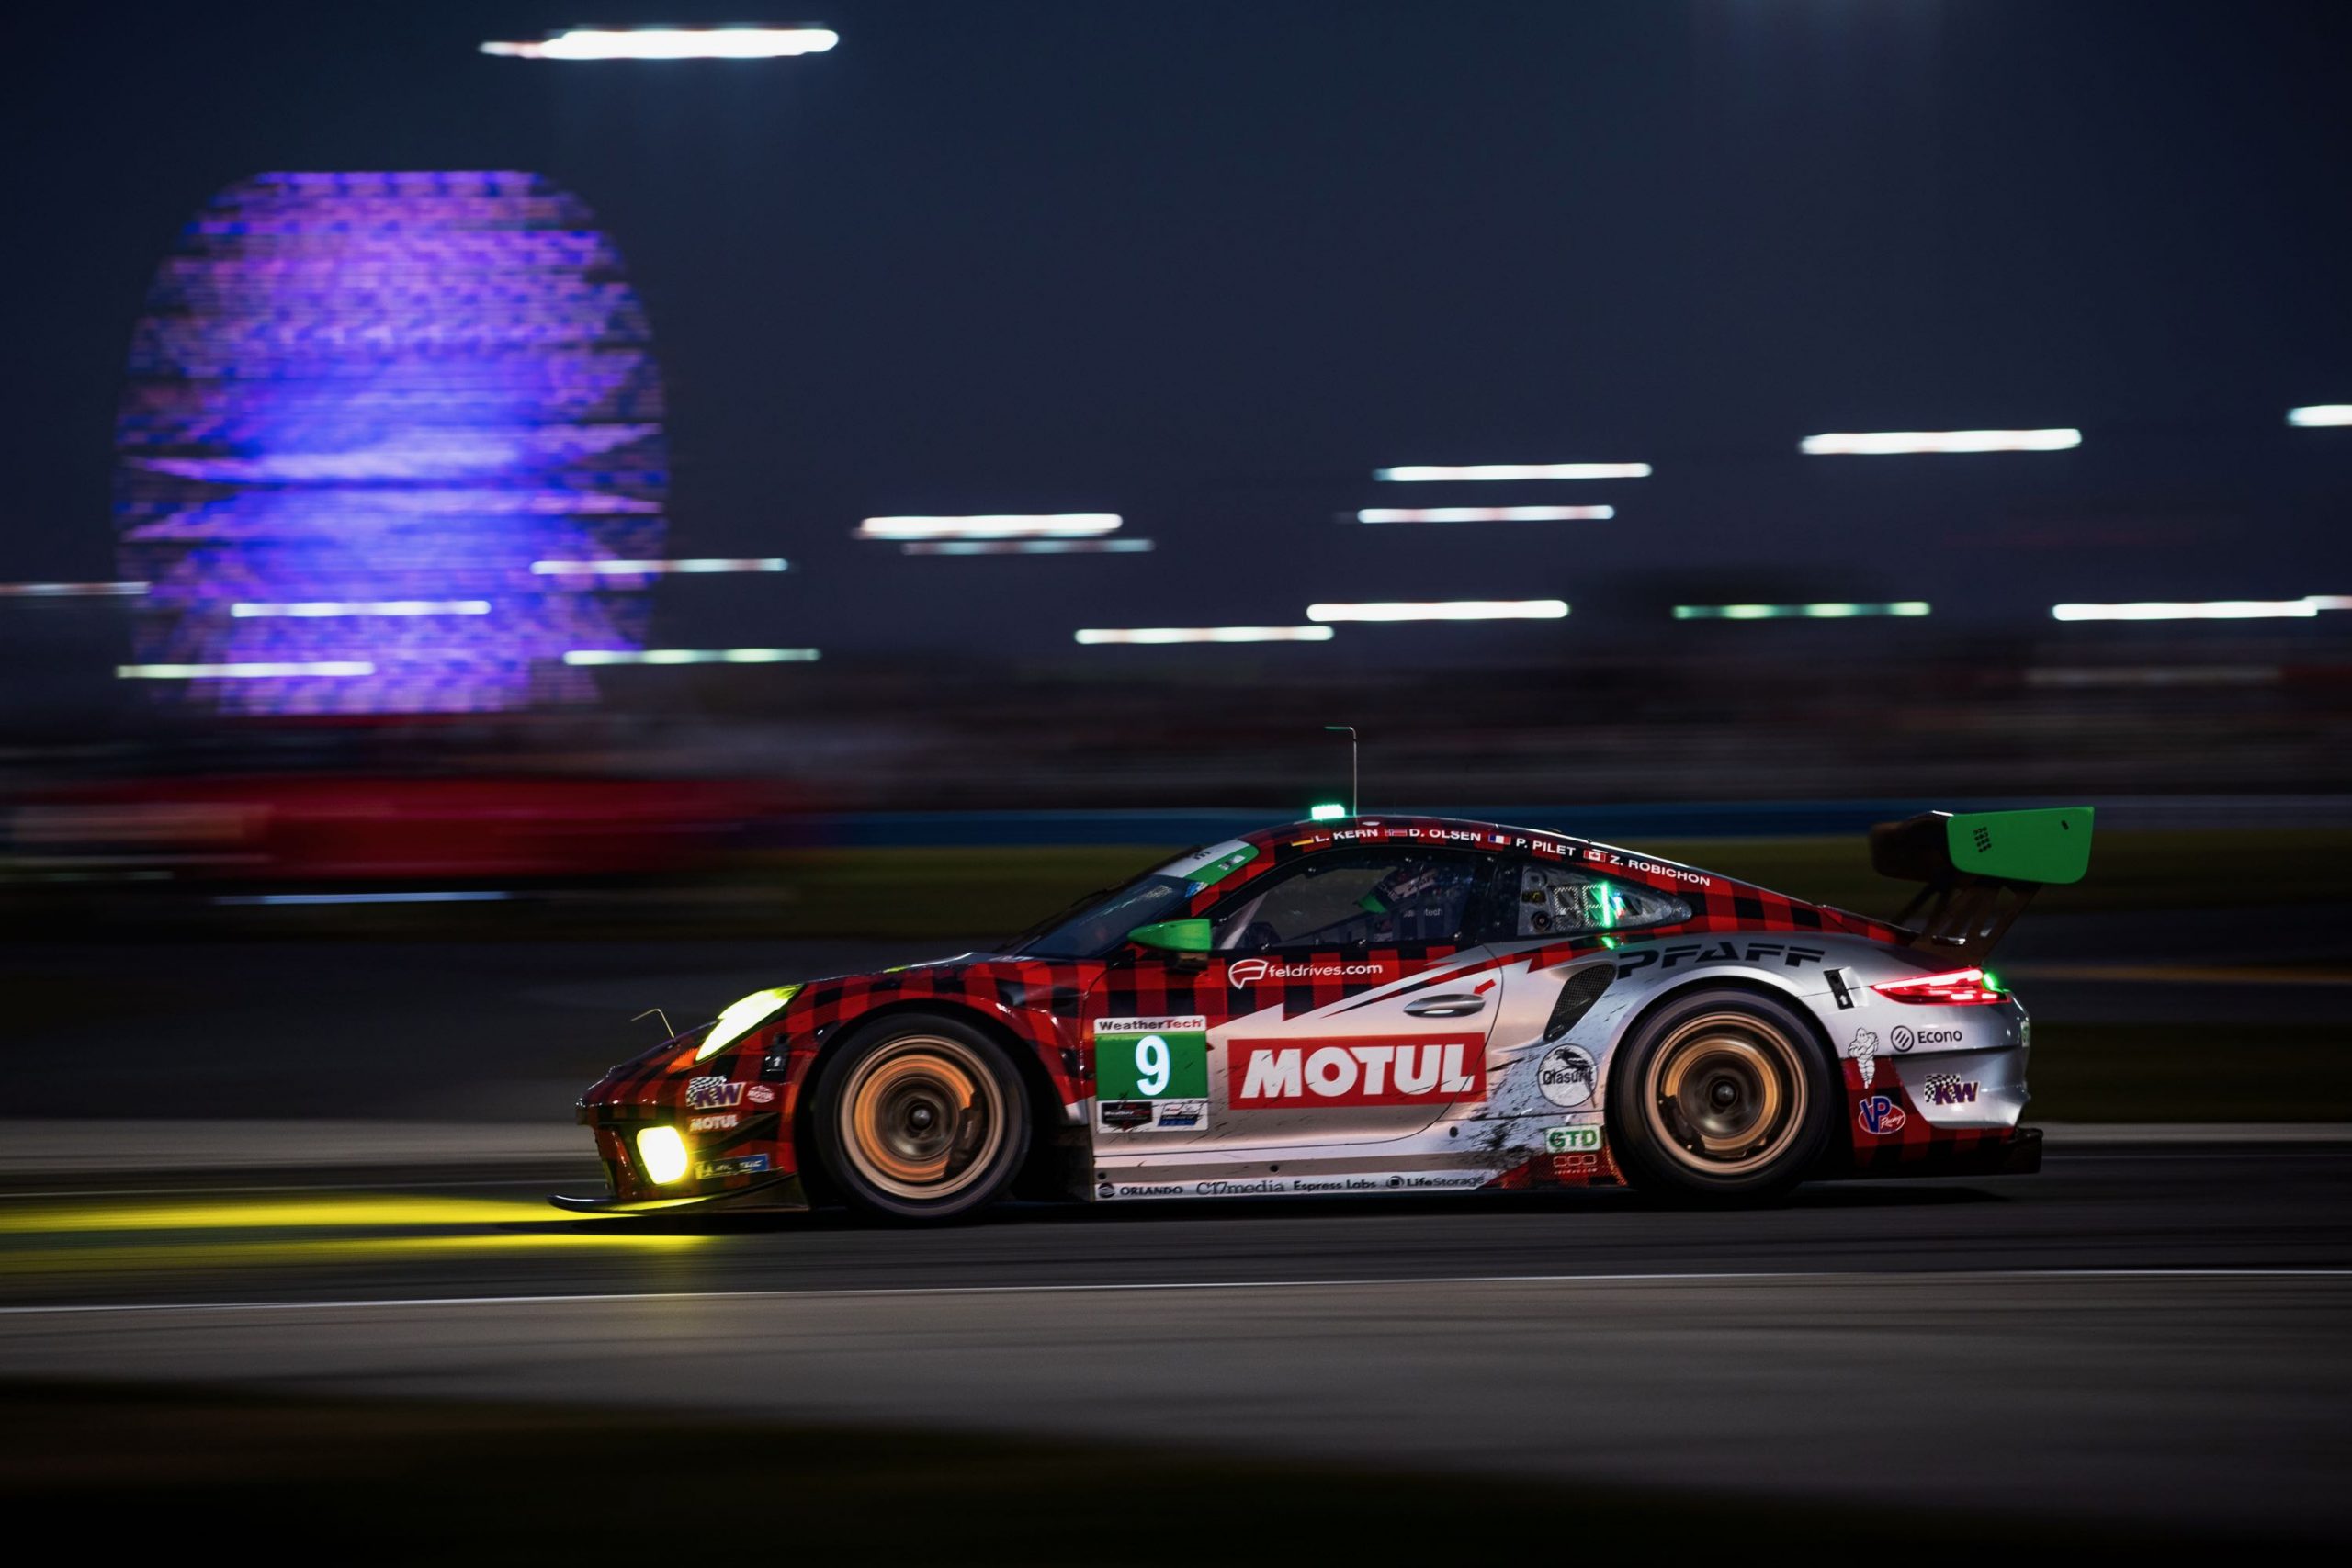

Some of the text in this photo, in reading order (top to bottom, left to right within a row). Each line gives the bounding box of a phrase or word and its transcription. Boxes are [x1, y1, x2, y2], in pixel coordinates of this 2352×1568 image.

[1315, 829, 1378, 843] L. KERN
[1409, 829, 1481, 842] D. OLSEN
[1516, 837, 1576, 856] P. PILET
[1609, 854, 1711, 886] Z. ROBICHON
[1268, 962, 1383, 978] feldrives.com
[1617, 942, 1825, 980] PFAFF
[1099, 1019, 1203, 1031] WeatherTech
[1917, 1030, 1962, 1044] Econo
[1136, 1034, 1170, 1096] 9
[1240, 1044, 1475, 1099] MOTUL
[695, 1084, 741, 1109] KW
[1934, 1081, 1979, 1106] KW
[690, 1114, 740, 1132] MOTUL
[1859, 1095, 1892, 1134] VP
[1549, 1129, 1598, 1148] GTD
[1119, 1186, 1183, 1196] ORLANDO
[1196, 1179, 1284, 1195] C17media
[1293, 1179, 1376, 1191] Espress Labs
